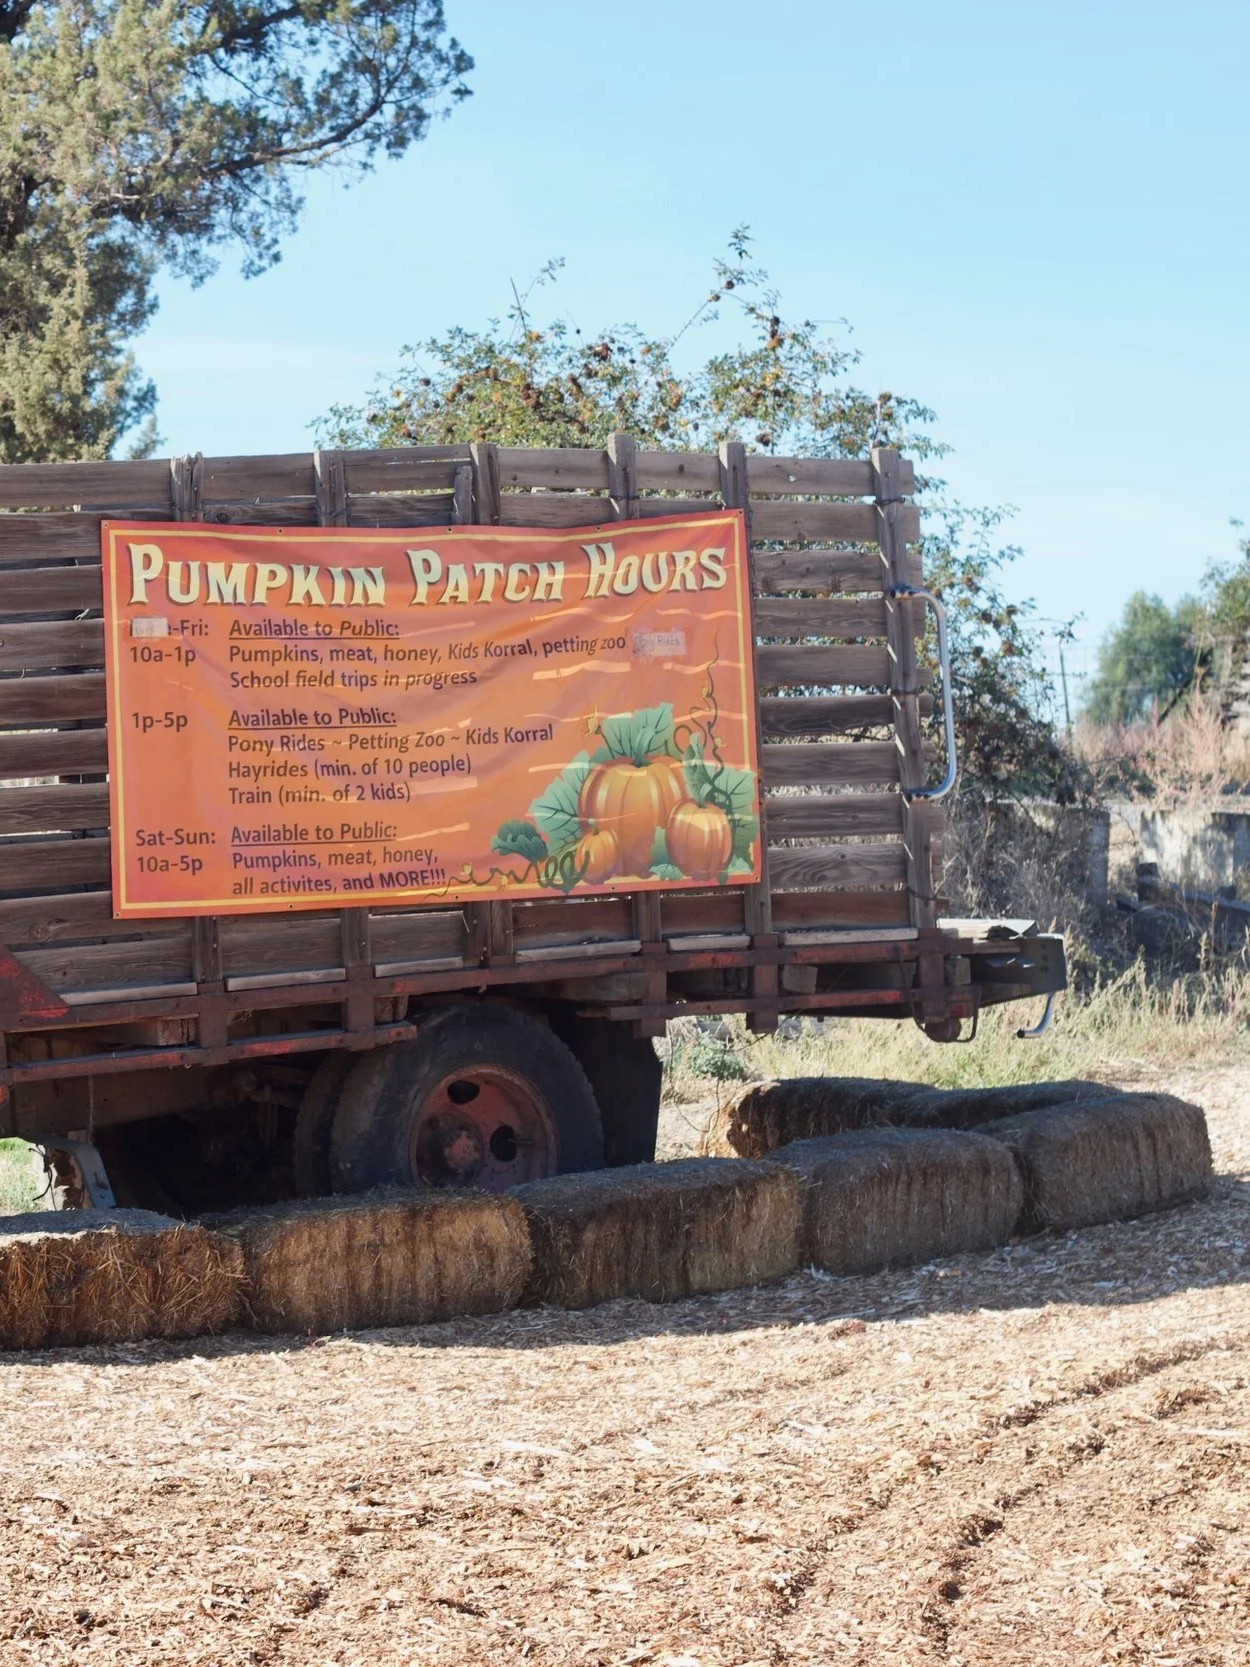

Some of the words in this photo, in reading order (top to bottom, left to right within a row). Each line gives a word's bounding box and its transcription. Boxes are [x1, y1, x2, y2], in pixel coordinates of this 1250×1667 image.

[128, 542, 387, 607] PUMPKIN
[406, 549, 565, 606] PATCH
[580, 542, 727, 600] HOURS
[230, 619, 309, 636] Available
[315, 621, 333, 636] to
[340, 620, 400, 636] Public:
[130, 646, 196, 667] 10a-1p
[229, 645, 323, 665] Pumpkins,
[329, 647, 377, 664] meat,
[384, 645, 442, 664] honey,
[448, 642, 478, 660] Kids
[483, 638, 538, 660] Korral,
[542, 635, 597, 658] petting
[230, 671, 289, 688] School
[296, 671, 335, 687] field
[341, 671, 378, 691] trips
[384, 671, 399, 686] in
[405, 669, 477, 690] progress
[131, 712, 188, 733] 1p-5p
[229, 709, 308, 727] Available
[314, 711, 332, 725] to
[339, 708, 397, 725] Public:
[228, 735, 274, 756] Pony
[281, 734, 325, 752] Rides
[349, 732, 409, 753] Petting
[415, 731, 445, 748] Zoo
[466, 727, 499, 745] Kids
[505, 724, 553, 744] Korral
[229, 760, 308, 782] Hayrides
[314, 758, 357, 780] (min.
[361, 758, 378, 775] of
[384, 758, 402, 774] 10
[409, 754, 471, 777] people)
[229, 786, 272, 804] Train
[278, 784, 326, 806] (min.
[333, 785, 350, 802] of
[356, 785, 366, 800] 2
[371, 781, 410, 803] kids)
[135, 829, 216, 846] Sat-Sun:
[231, 826, 309, 843] Available
[315, 825, 333, 841] to
[340, 821, 397, 840] Public:
[137, 855, 203, 876] 10a-5p
[233, 850, 321, 872] Pumpkins,
[328, 850, 377, 867] meat,
[383, 846, 438, 865] honey,
[233, 878, 253, 895] all
[260, 876, 336, 894] activites,
[343, 873, 374, 890] and
[380, 868, 446, 888] MORE!!!
